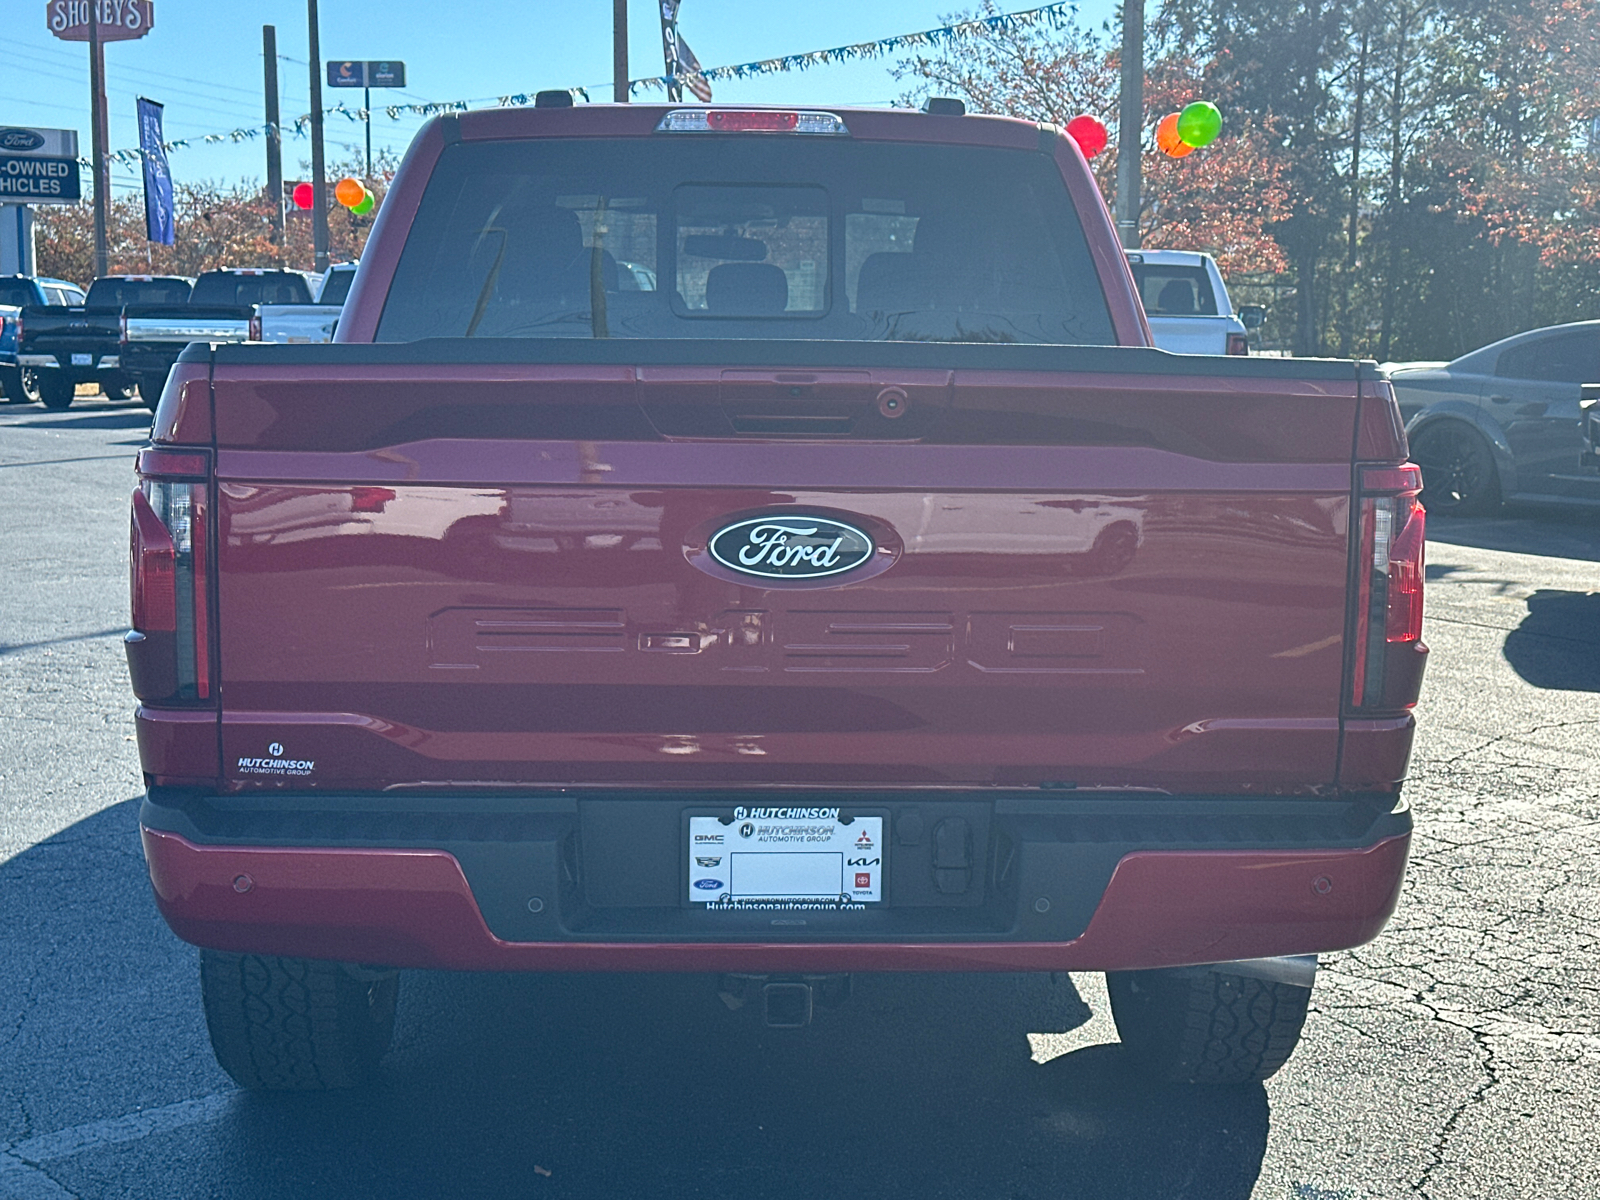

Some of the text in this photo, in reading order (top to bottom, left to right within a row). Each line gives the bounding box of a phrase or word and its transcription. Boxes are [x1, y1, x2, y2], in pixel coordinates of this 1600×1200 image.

[4, 133, 34, 147] Ford
[0, 160, 69, 177] -OWNED
[738, 525, 843, 568] Ford
[238, 757, 315, 770] HUTCHINSON
[239, 766, 285, 775] AUTOMOTIVE
[749, 807, 840, 819] HUTCHINSON
[757, 825, 836, 836] HUTCHINSON
[706, 901, 866, 910] Hutchinsonautogroupcom
